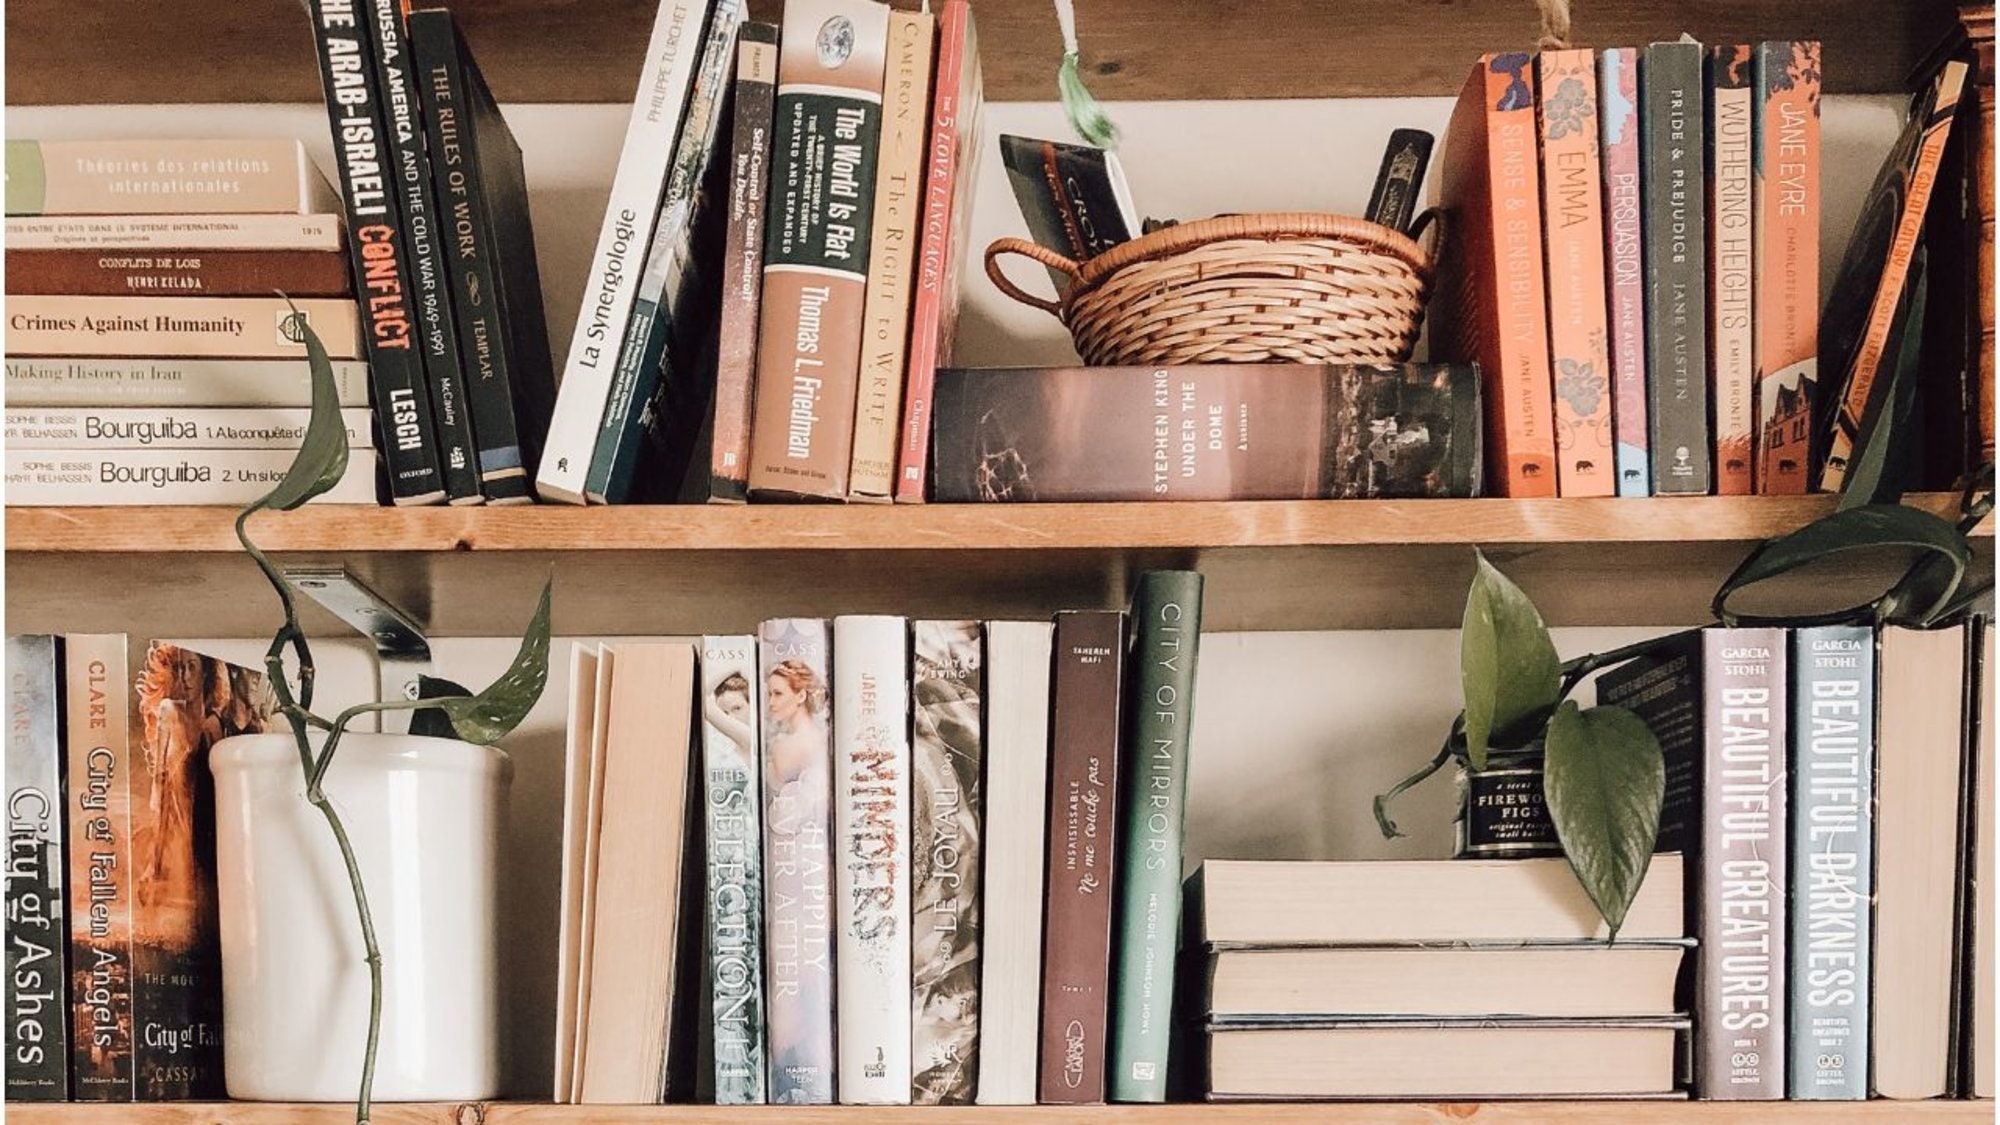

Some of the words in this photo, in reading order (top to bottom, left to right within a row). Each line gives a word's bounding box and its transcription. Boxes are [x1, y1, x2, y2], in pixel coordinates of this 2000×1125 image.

[318, 0, 355, 28] HE
[432, 64, 450, 102] THE
[648, 67, 672, 123] PHILIPPE
[662, 4, 687, 64] TURCHET
[897, 22, 919, 120] CAMERON
[327, 37, 387, 215] ARAB-ISRAELI
[388, 67, 413, 143] AMERICA
[808, 115, 817, 131] THE
[835, 107, 865, 140] The
[937, 116, 954, 128] 5
[1671, 89, 1684, 140] PRIDE
[438, 107, 462, 166] RULES
[790, 102, 803, 157] UPDATED
[817, 134, 825, 142] A
[1780, 102, 1805, 157] JANE
[76, 158, 153, 174] Théories
[156, 158, 185, 173] des
[193, 158, 270, 173] relations
[401, 150, 419, 182] AND
[737, 153, 749, 175] You
[748, 128, 763, 200] Self-Control
[788, 163, 799, 187] AND
[830, 145, 862, 198] World
[934, 133, 951, 177] LOVE
[1501, 124, 1526, 189] SENSE
[1671, 149, 1684, 161] &
[1721, 101, 1748, 229] WUTHERING
[108, 178, 241, 194] internationales
[407, 185, 424, 213] THE
[449, 170, 468, 197] OF
[1506, 198, 1525, 212] &
[1557, 151, 1589, 229] EMMA
[1780, 163, 1806, 217] EYRE
[1906, 172, 1935, 217] GREAT
[173, 223, 239, 232] INTERNATIONAL
[454, 202, 476, 258] WORK
[747, 203, 757, 215] or
[783, 192, 796, 254] EXPANDED
[828, 201, 858, 220] Is
[1613, 173, 1640, 286] PERSUASION
[1671, 169, 1686, 263] PREJUDICE
[412, 216, 431, 255] COLD
[744, 218, 757, 247] State
[824, 223, 856, 260] Flat
[923, 184, 946, 294] LANGUAGES
[1893, 220, 1919, 268] GATSBY
[98, 258, 153, 269] CONFLITS
[156, 258, 172, 269] DE
[175, 258, 201, 269] LOIS
[127, 276, 158, 289] HENRI
[161, 276, 202, 289] KELADA
[418, 258, 436, 290] WAR
[587, 208, 636, 341] Synergologie
[1507, 221, 1537, 343] SENSIBILITY
[1721, 239, 1748, 330] HEIGHTS
[1786, 227, 1798, 300] CHARLOTTE
[358, 224, 411, 349] CONFLICT
[1673, 282, 1686, 325] JANE
[11, 314, 76, 331] Crimes
[80, 315, 150, 333] Against
[155, 316, 246, 336] Humanity
[423, 293, 445, 356] 1949-1991
[796, 286, 830, 354] Thomas
[1622, 297, 1633, 325] JANE
[473, 317, 493, 380] TEMPLAR
[579, 345, 601, 369] La
[795, 358, 824, 372] L.
[1518, 352, 1532, 384] JANE
[1623, 328, 1635, 381] AUSTEN
[1674, 331, 1687, 400] AUSTEN
[1729, 339, 1740, 376] EMILY
[5, 365, 63, 384] Making
[68, 365, 123, 384] History
[131, 366, 145, 380] in
[151, 366, 182, 380] Iran
[870, 351, 894, 427] WRITE
[1154, 369, 1168, 407] KING
[440, 377, 455, 426] McCauley
[787, 375, 822, 460] Friedman
[1182, 382, 1195, 412] THE
[1522, 388, 1536, 437] AUSTEN
[23, 428, 78, 438] BELHASSEN
[85, 416, 198, 444] Bourguiba
[390, 389, 422, 450] LESCH
[1209, 404, 1222, 450] DOME
[60, 462, 93, 470] BESSIS
[1154, 415, 1168, 493] STEPHEN
[1182, 419, 1195, 477] UNDER
[37, 474, 92, 484] BELHASSEN
[100, 461, 211, 488] Bourguiba
[706, 650, 745, 660] CASS
[775, 643, 817, 656] CASS
[1072, 647, 1111, 656] TAHEREH
[1160, 603, 1182, 672] CITY
[1721, 647, 1771, 659] GARCIA
[1812, 640, 1862, 651] GARCIA
[931, 670, 967, 680] EWING
[1724, 665, 1767, 676] STOHL
[1815, 657, 1858, 668] STOHL
[88, 660, 107, 729] CLARE
[861, 673, 877, 715] JAFFE
[1155, 685, 1177, 724] OF
[80, 747, 115, 811] City
[710, 769, 747, 783] THE
[1088, 756, 1105, 787] pas
[1721, 688, 1770, 849] BEAUTIFUL
[1809, 680, 1859, 841] BEAUTIFUL
[1146, 739, 1175, 871] MIRRORS
[1477, 793, 1542, 807] FIREWO
[1501, 807, 1540, 819] FIGS
[5, 787, 50, 881] City
[92, 817, 115, 846] of
[772, 795, 798, 878] EVER
[850, 752, 898, 940] MINDERS
[934, 787, 960, 888] JOYAU
[1067, 780, 1080, 870] INSAISISSABLE
[1085, 844, 1095, 868] me
[90, 851, 118, 938] Fallen
[803, 822, 826, 975] HAPPILY
[1078, 872, 1099, 895] Ne
[20, 893, 50, 930] of
[709, 787, 753, 1025] SELECTION
[934, 898, 957, 932] LE
[1146, 892, 1157, 940] MELODIE
[775, 894, 799, 1001] AFTER
[1721, 860, 1770, 1031] CREATURES
[1807, 853, 1857, 1007] DARKNESS
[145, 973, 165, 985] THE
[1142, 945, 1155, 998] JOHNSON
[14, 935, 54, 1064] Ashes
[85, 948, 118, 1046] Angels
[145, 1023, 177, 1054] City
[181, 1024, 194, 1042] of
